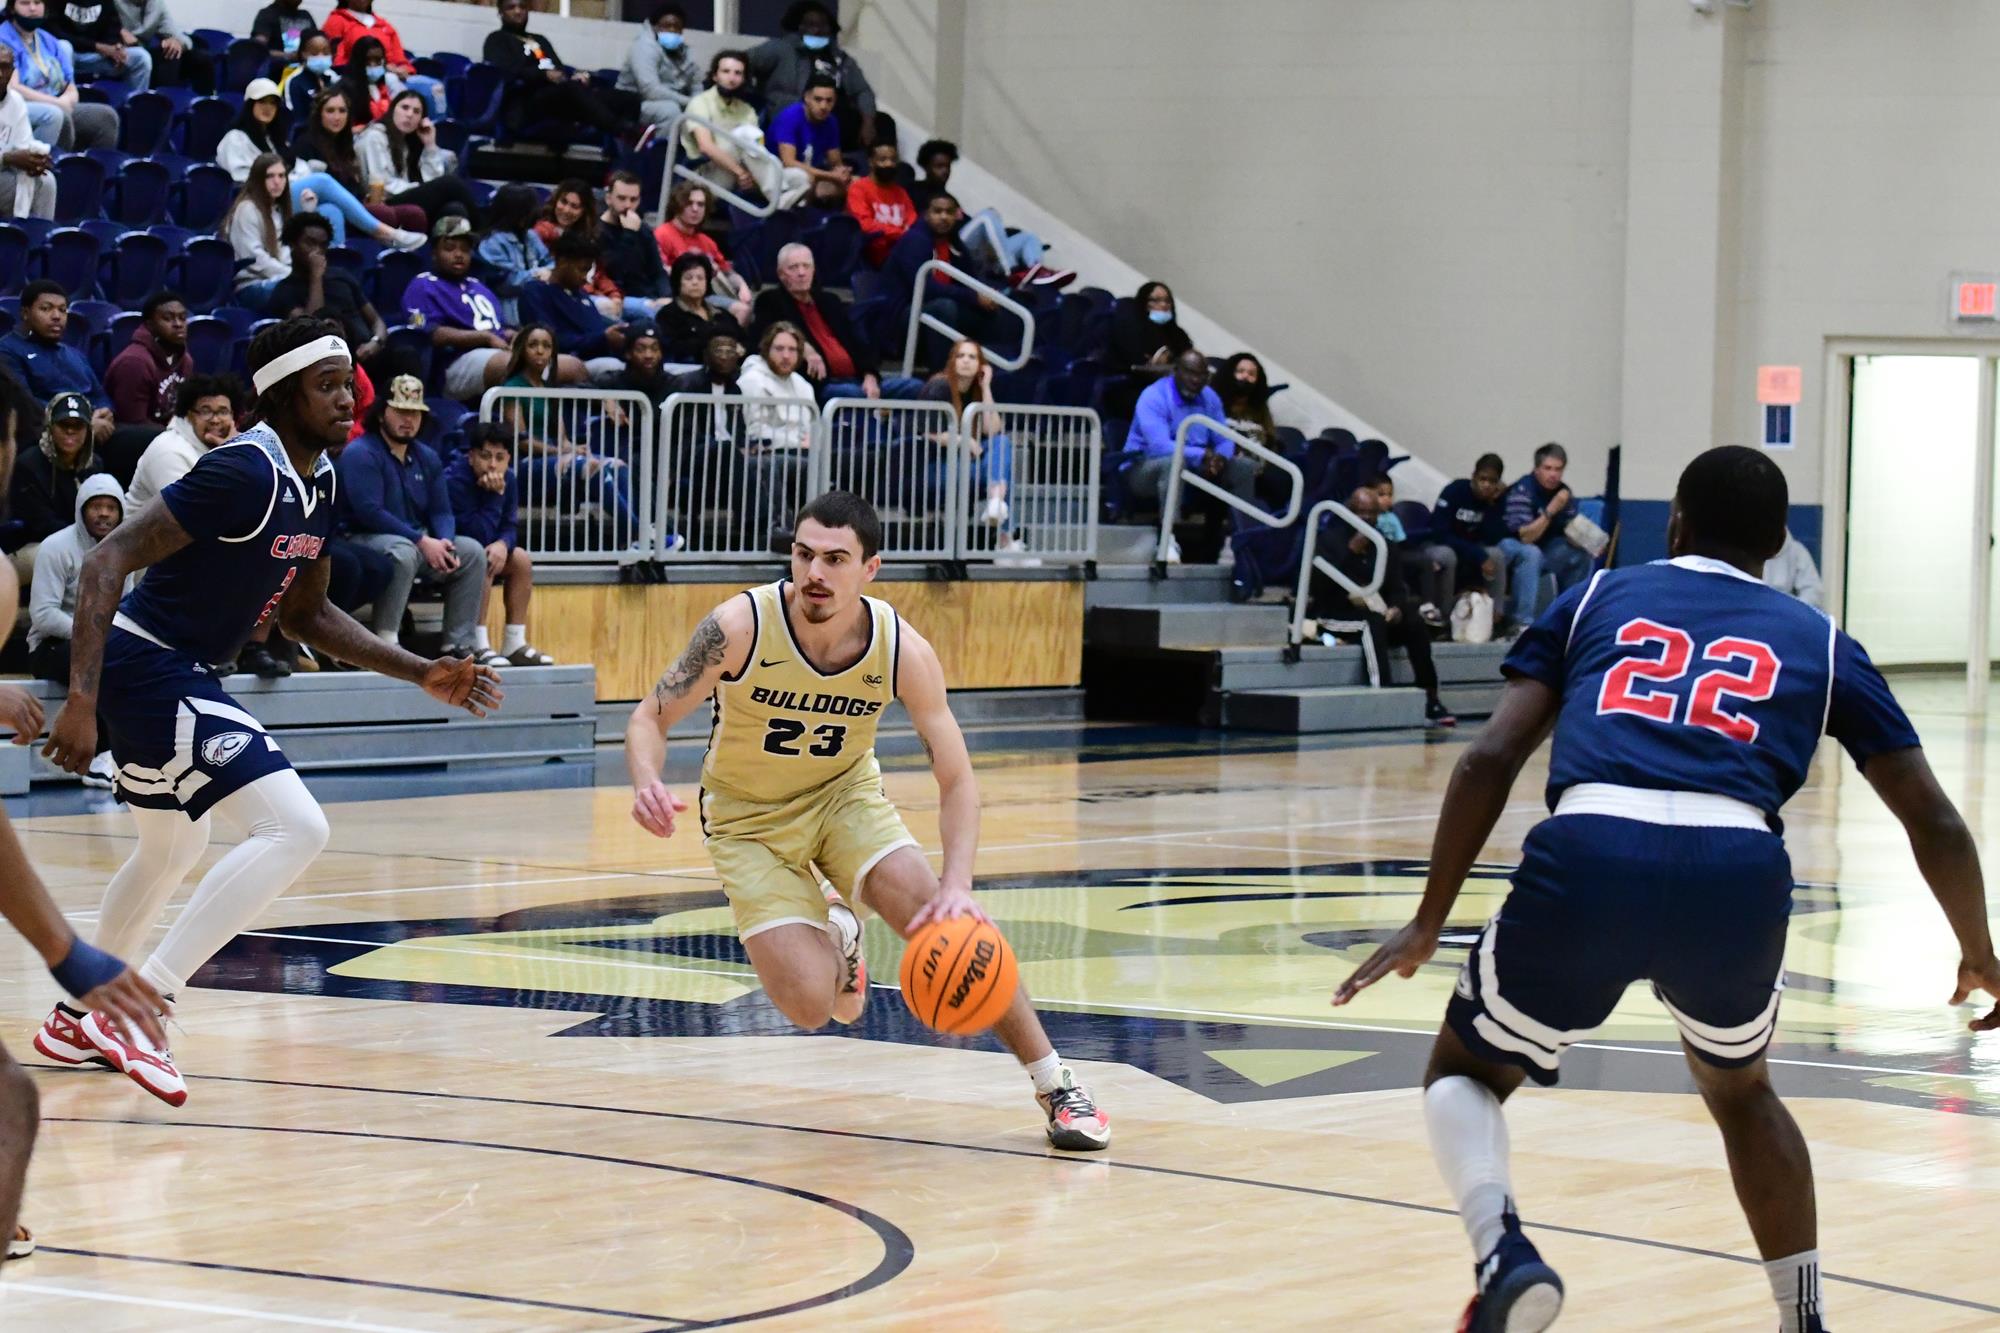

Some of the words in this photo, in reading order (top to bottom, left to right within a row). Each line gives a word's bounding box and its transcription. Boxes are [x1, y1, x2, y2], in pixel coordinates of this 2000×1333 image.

[750, 685, 883, 717] BULLDOGS
[1596, 617, 1782, 744] 22
[763, 717, 847, 758] 23
[947, 939, 995, 1010] Wilson
